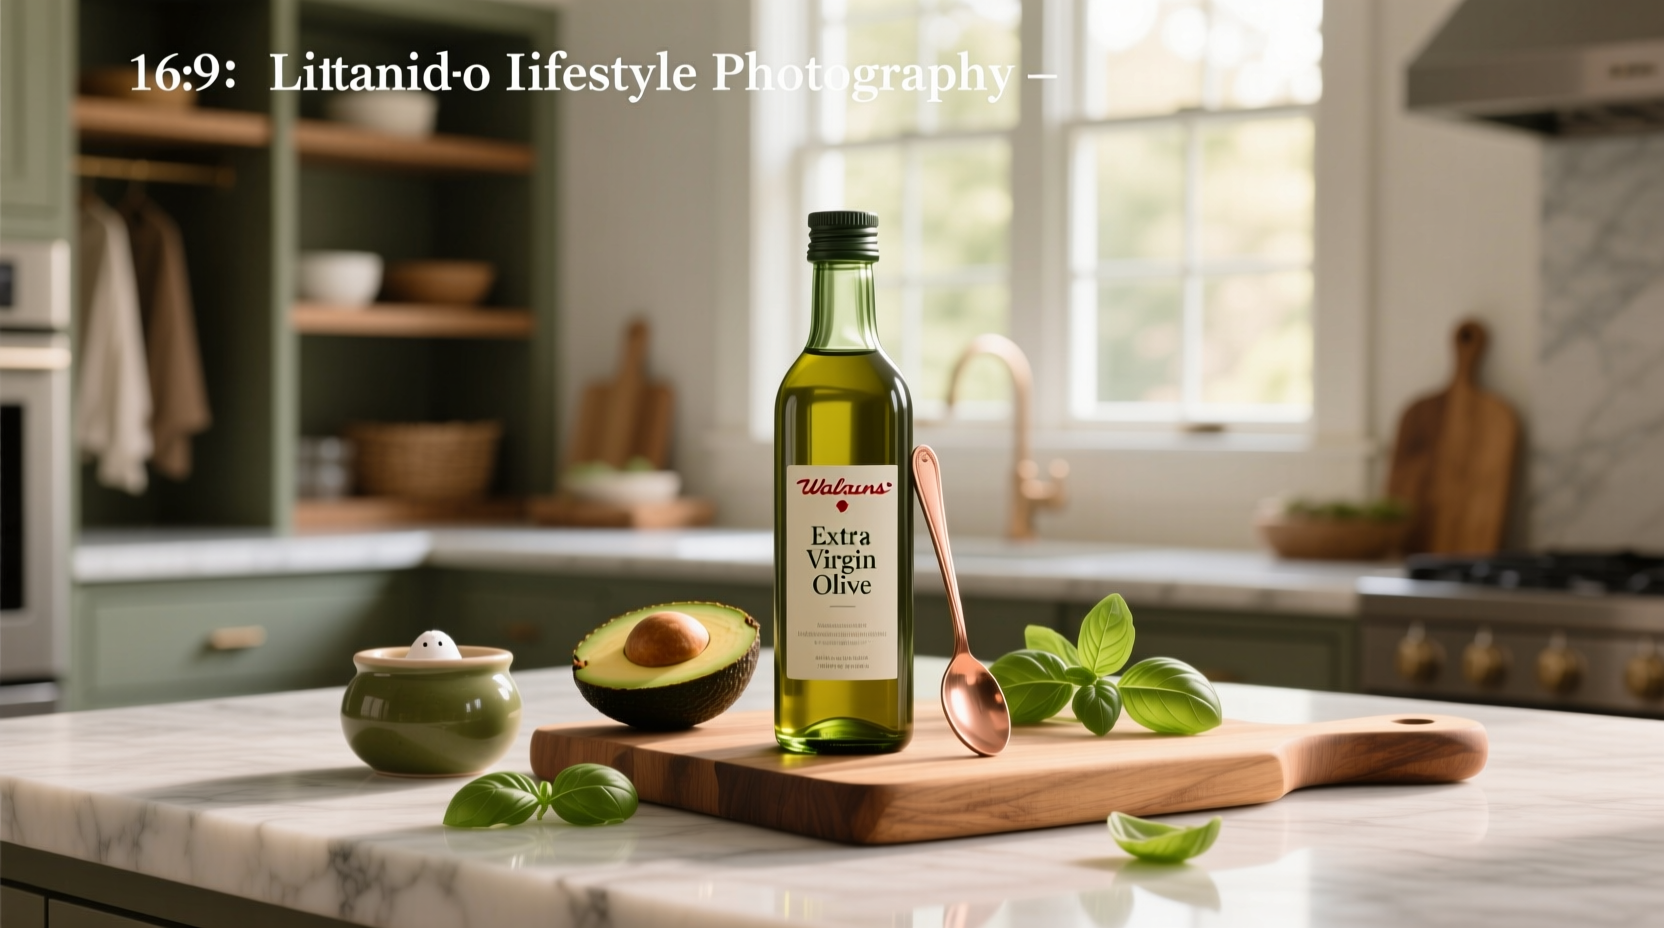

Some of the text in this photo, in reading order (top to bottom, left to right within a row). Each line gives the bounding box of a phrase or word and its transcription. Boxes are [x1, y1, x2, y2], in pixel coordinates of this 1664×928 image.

[810, 525, 871, 546] Extra
[806, 548, 877, 575] Virgin
[812, 573, 873, 596] Olive
